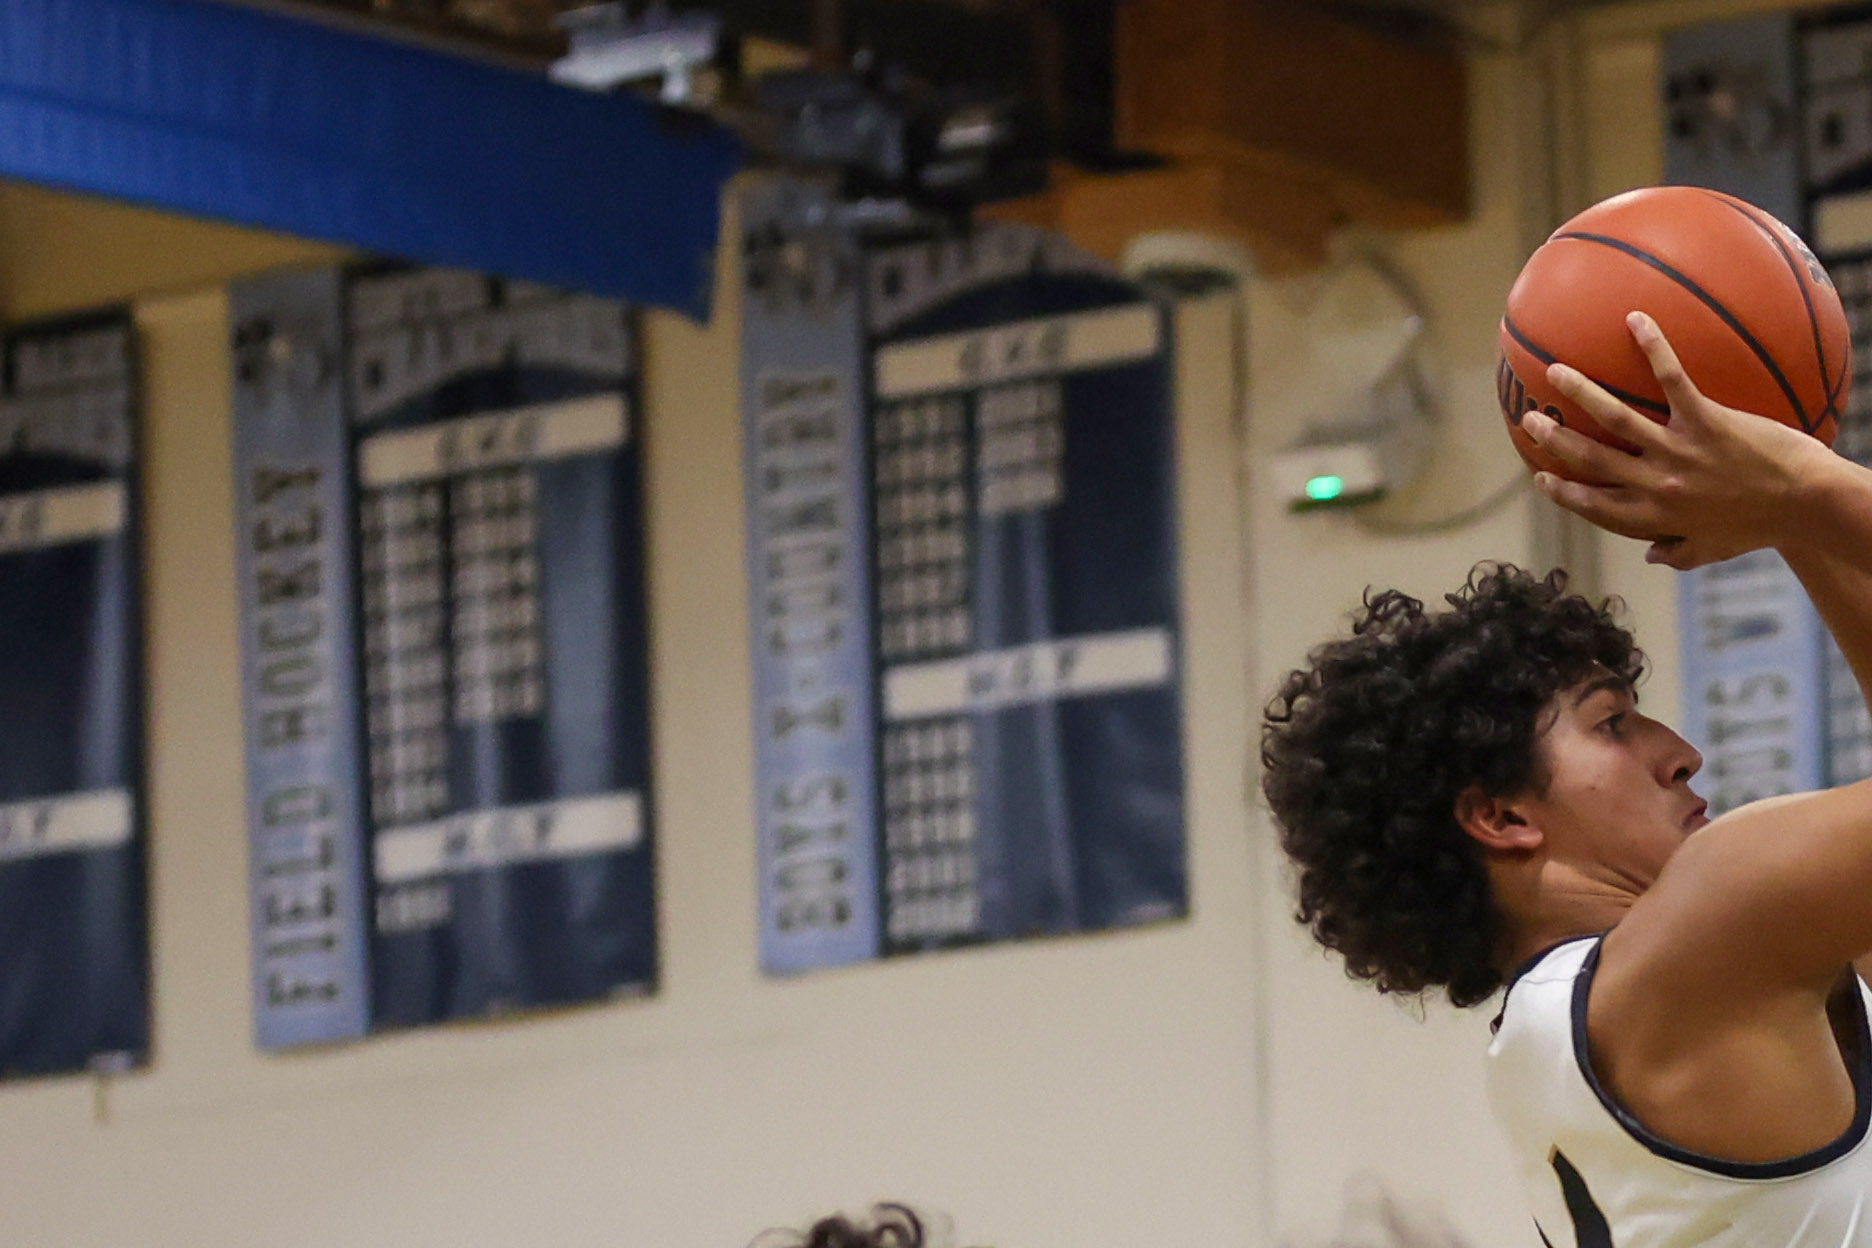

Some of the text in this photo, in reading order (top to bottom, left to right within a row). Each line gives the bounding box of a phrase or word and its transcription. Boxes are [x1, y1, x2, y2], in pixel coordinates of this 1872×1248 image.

[250, 462, 342, 1009] FIELD HOCKEY
[772, 775, 853, 933] BOYS
